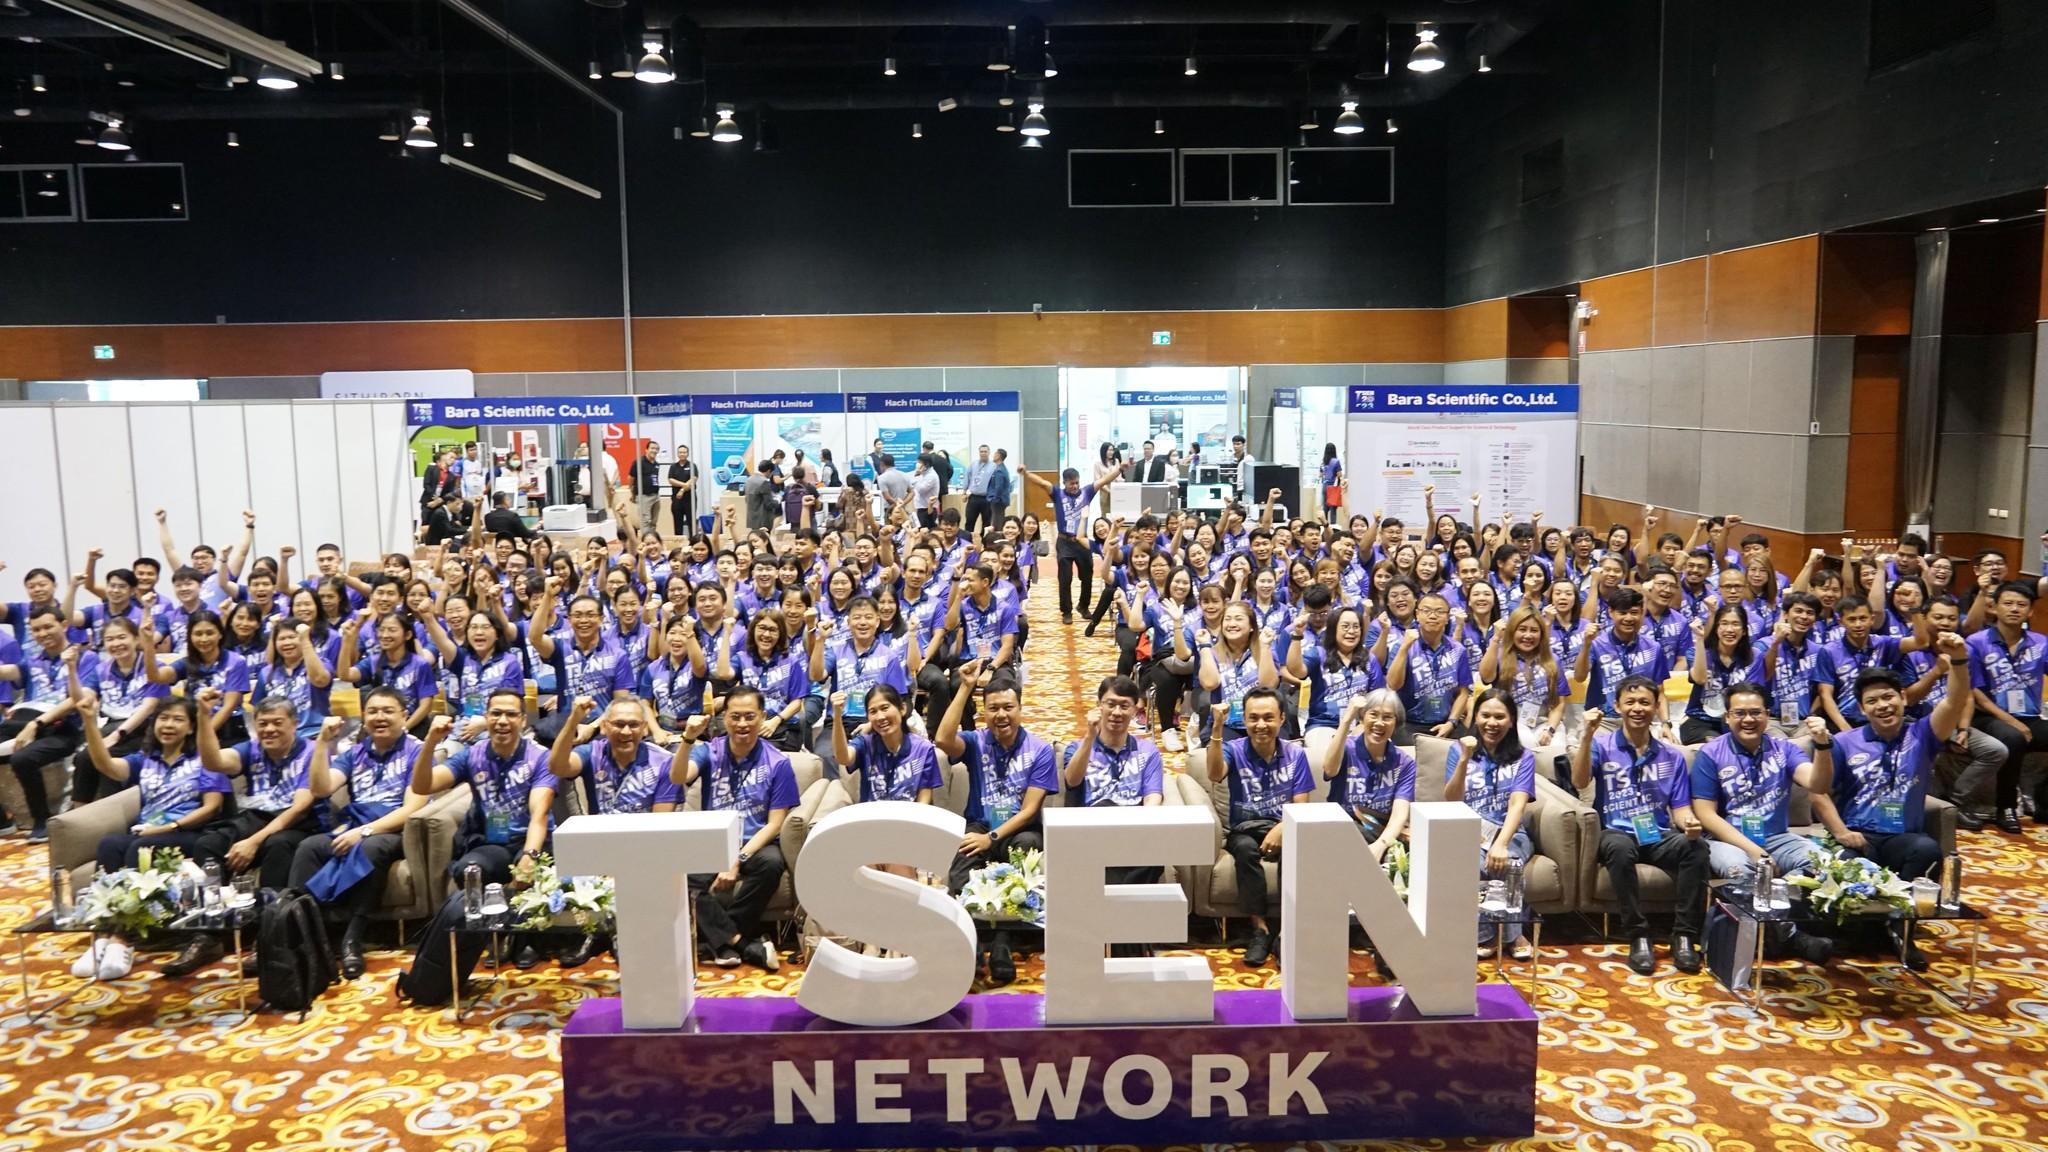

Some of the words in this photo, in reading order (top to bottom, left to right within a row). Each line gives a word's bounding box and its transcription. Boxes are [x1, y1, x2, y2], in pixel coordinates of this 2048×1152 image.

[711, 400, 734, 410] Hach
[735, 399, 779, 410] (Thailand)
[780, 399, 813, 409] Limited
[885, 398, 908, 407] Hach
[909, 398, 952, 408] (Thailand)
[954, 398, 988, 407] Limited
[1137, 394, 1152, 403] C.E.
[1154, 393, 1201, 402] Combination
[1387, 393, 1423, 406] Bara
[1426, 392, 1499, 406] Scientific
[1502, 392, 1558, 407] Co.,Ltd.
[445, 406, 481, 419] Bara
[483, 404, 555, 418] Scientific
[558, 404, 614, 418] Co.,Ltd.
[1601, 651, 1645, 678] TSN
[1346, 769, 1393, 795] TSN
[1603, 763, 1658, 791] TSN
[1722, 756, 1779, 797] TSN
[1465, 787, 1489, 801] 2023
[1603, 793, 1653, 814] SCIENTIC
[554, 801, 1481, 1029] TSEN
[771, 1051, 1331, 1125] NETWORK
